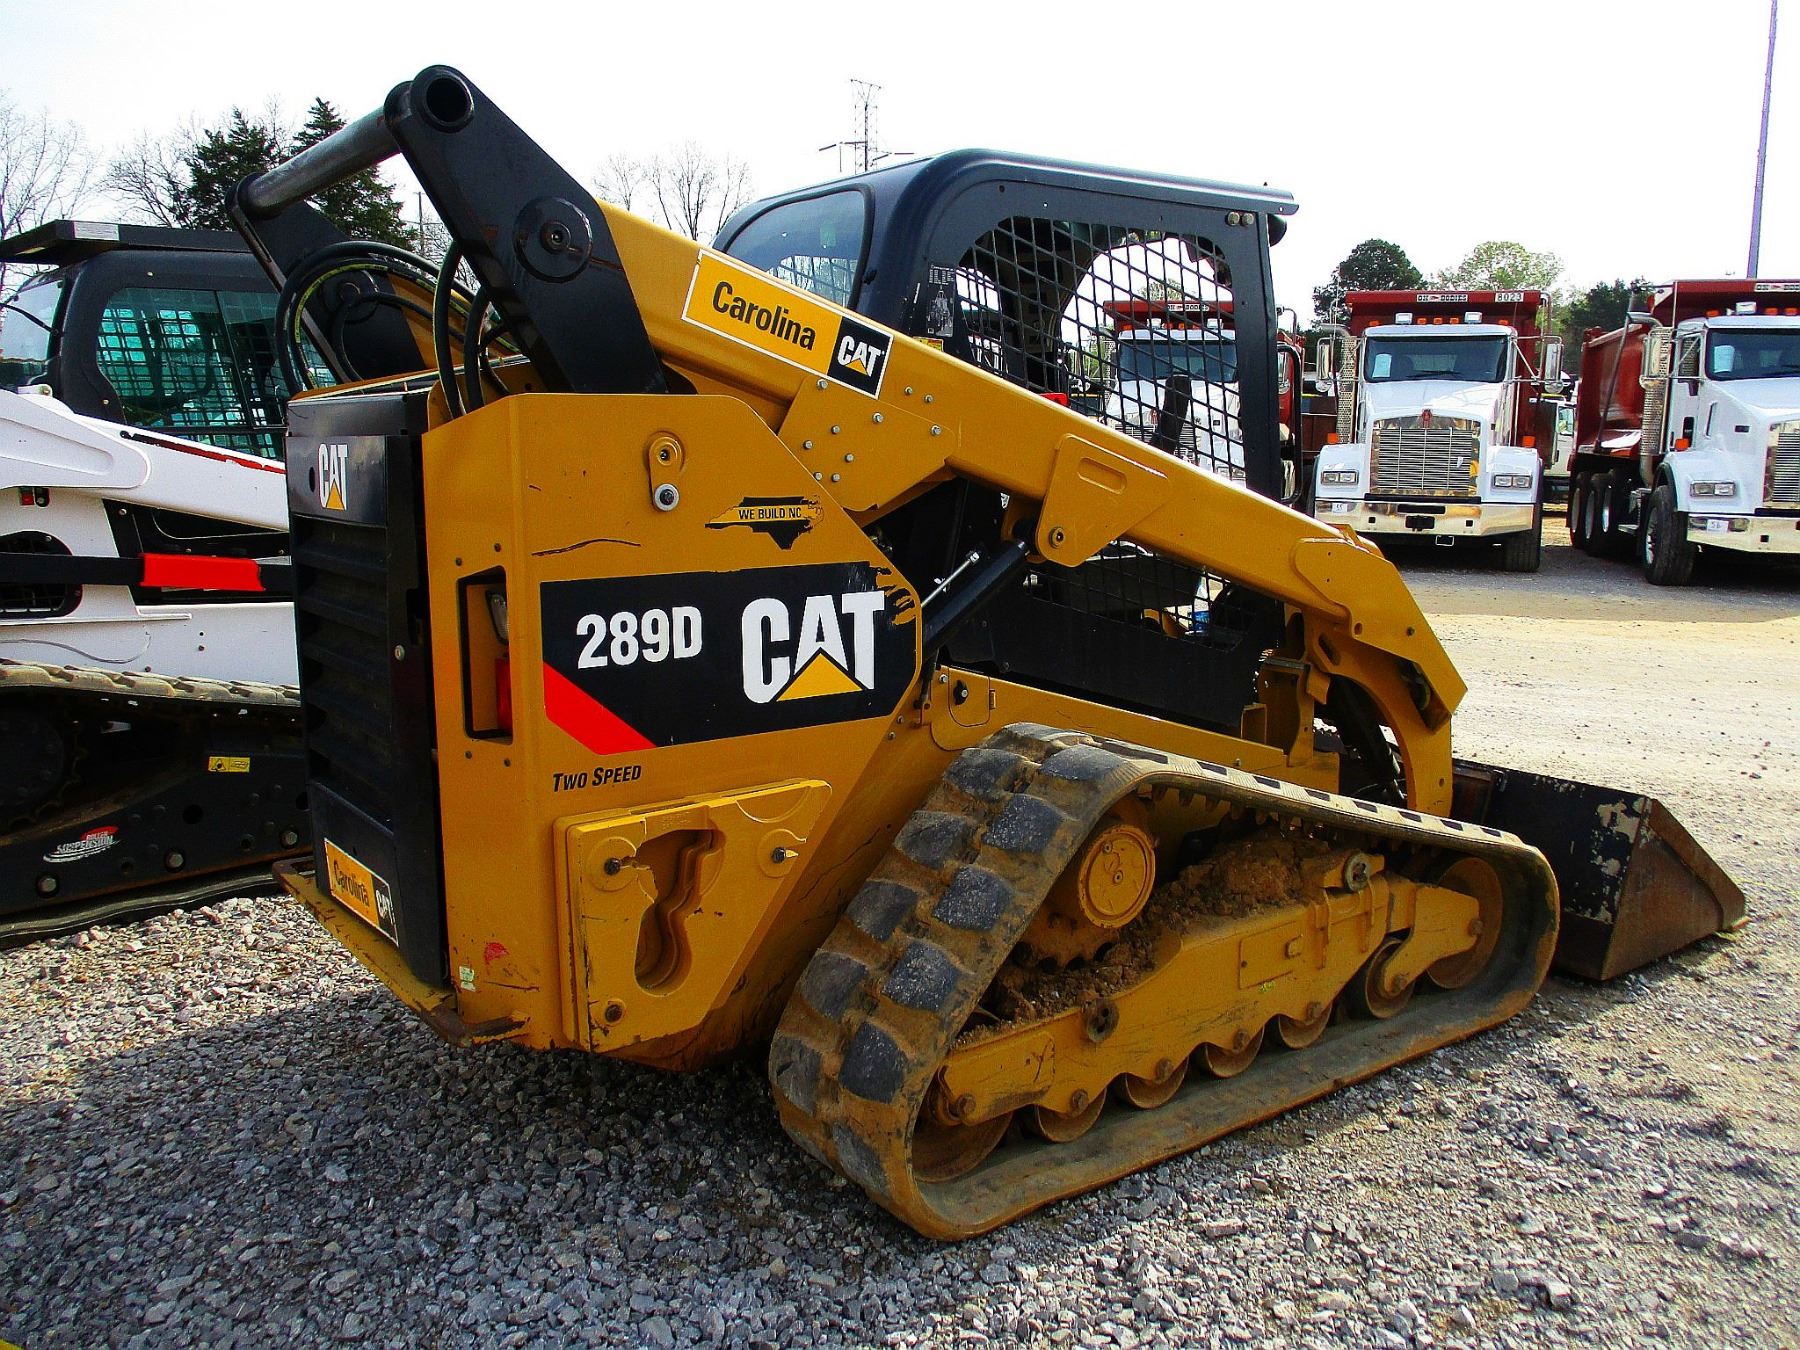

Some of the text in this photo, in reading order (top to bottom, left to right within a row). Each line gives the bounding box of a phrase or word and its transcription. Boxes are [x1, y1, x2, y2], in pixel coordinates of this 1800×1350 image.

[1497, 292, 1522, 302] 8023
[712, 281, 882, 377] Carolina CAT
[318, 443, 348, 511] CAT
[739, 507, 802, 520] WE BUILD NC
[576, 590, 885, 704] 289D CAT
[56, 835, 113, 854] SUSPENSION
[333, 860, 370, 907] Carolina
